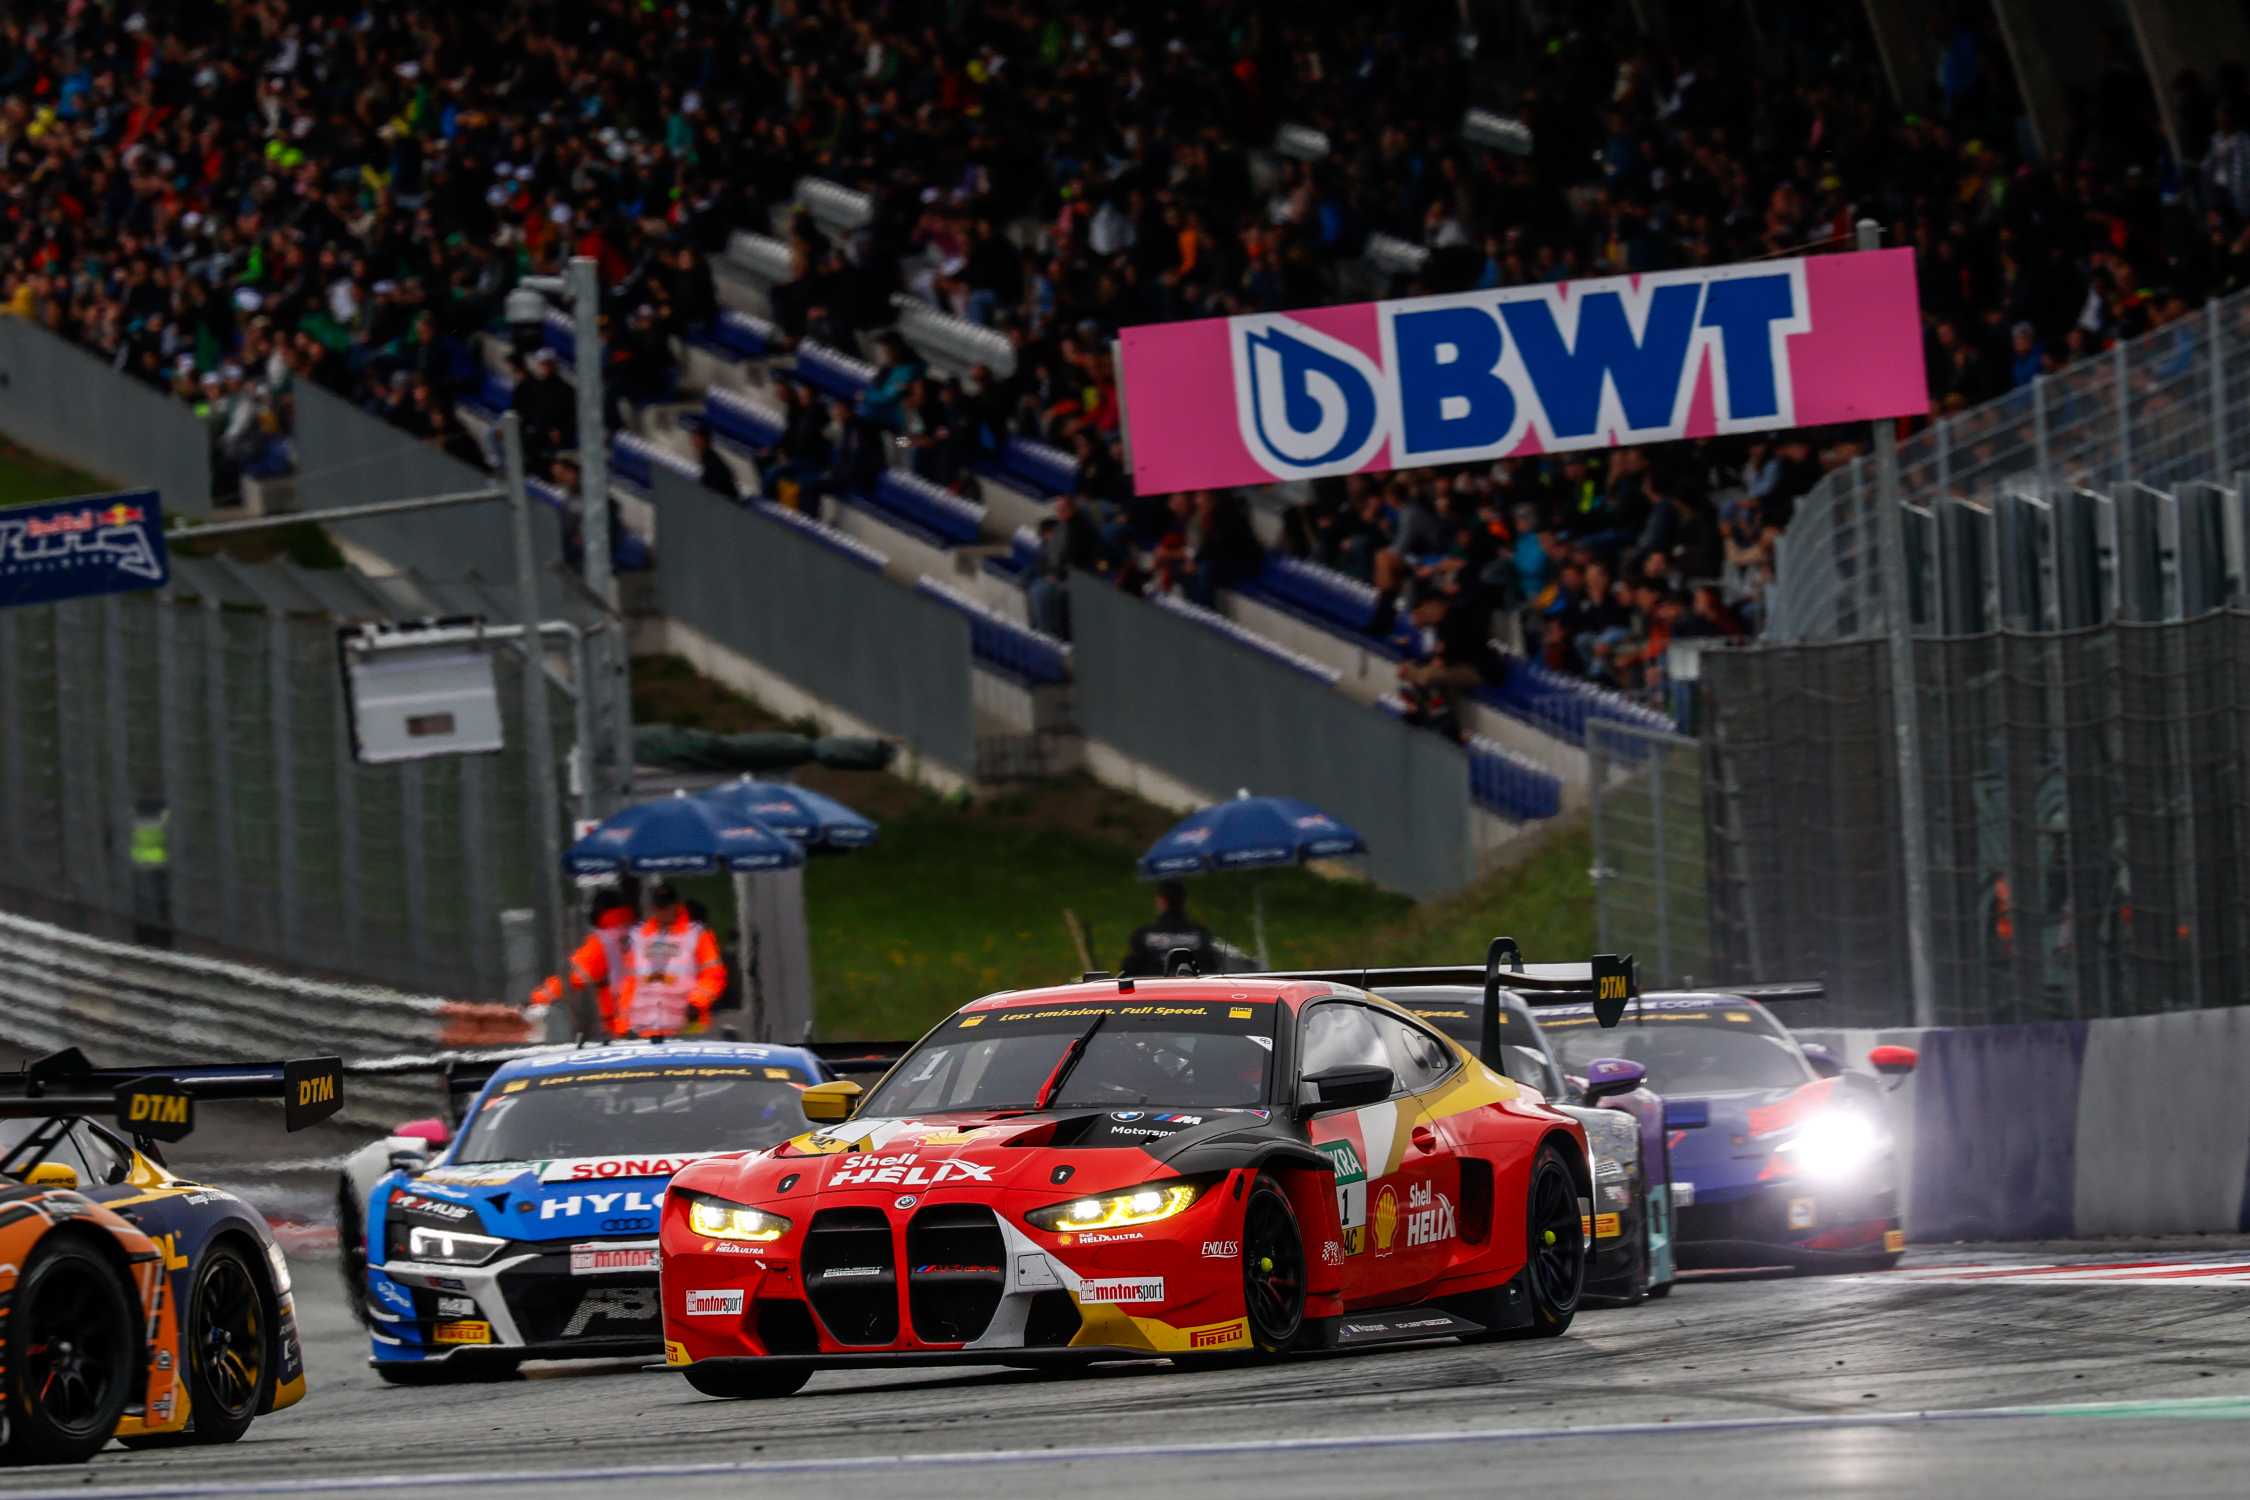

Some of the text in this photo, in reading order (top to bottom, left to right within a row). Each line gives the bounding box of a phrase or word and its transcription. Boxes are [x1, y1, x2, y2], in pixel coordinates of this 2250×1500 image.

[1393, 272, 1796, 455] BWT
[1600, 976, 1627, 999] DTM
[1000, 1005, 1208, 1022] Less emissions. Full Speed.
[912, 1050, 949, 1082] 1
[299, 1074, 335, 1106] DTM
[129, 1093, 189, 1123] DTM
[573, 1157, 696, 1180] SONAX
[828, 1158, 997, 1187] HELIX
[842, 1153, 919, 1169] Shell
[1329, 1146, 1363, 1178] KRA
[1341, 1188, 1350, 1226] 1
[1409, 1179, 1432, 1209] Shell
[1407, 1193, 1457, 1247] HELIX
[1112, 1232, 1144, 1241] ULTRA
[1202, 1241, 1238, 1255] ENDLESS
[696, 1295, 742, 1313] motorsport
[1095, 1283, 1163, 1301] motorsport
[1190, 1323, 1243, 1348] PIRELLI
